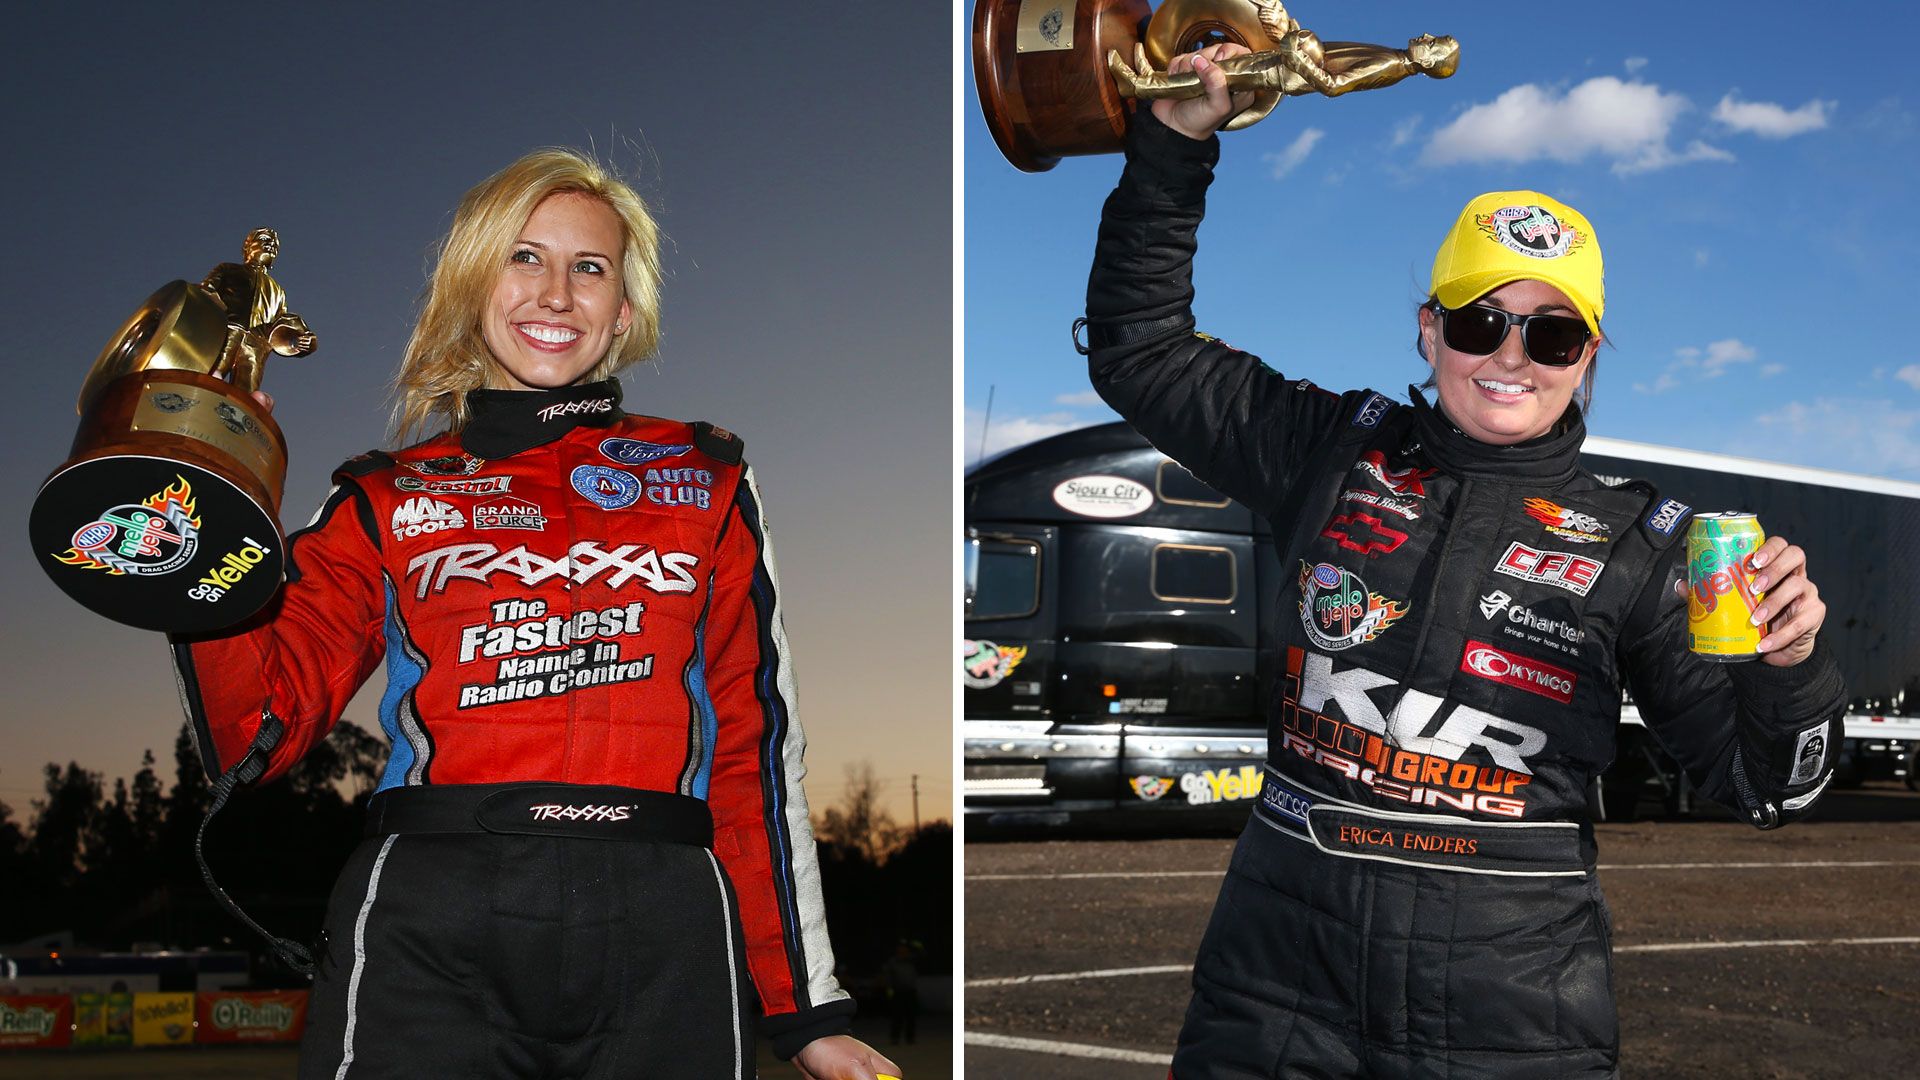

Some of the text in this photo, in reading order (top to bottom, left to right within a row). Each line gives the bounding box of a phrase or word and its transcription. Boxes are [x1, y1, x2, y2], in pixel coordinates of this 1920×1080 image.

[1510, 207, 1554, 234] mello
[1520, 223, 1558, 249] yello
[537, 398, 612, 422] TRAXXAS
[619, 443, 672, 459] Ford
[425, 476, 502, 493] Castrol
[591, 479, 620, 491] AAA
[645, 468, 713, 488] AUTO
[1066, 481, 1142, 499] Sioux City
[476, 505, 538, 515] BRAND
[646, 485, 712, 510] CLUB
[392, 497, 464, 529] MAC
[476, 516, 541, 527] SOURCE
[79, 525, 111, 546] NHRA
[104, 512, 149, 558] mello
[138, 517, 182, 557] yello
[393, 520, 465, 541] TOOLS
[163, 556, 185, 570] RACING
[184, 540, 194, 557] SERIES
[198, 536, 271, 590] Yello!
[1501, 544, 1601, 589] CFE
[406, 541, 699, 599] TRAXXAS
[1497, 567, 1526, 579] RACING
[188, 584, 211, 600] Go
[206, 587, 226, 603] on
[1316, 573, 1362, 611] mello
[493, 599, 546, 622] The
[1321, 604, 1363, 636] yello
[1508, 605, 1585, 643] Charter
[459, 602, 644, 663] Fastest
[1306, 620, 1351, 648] DRAG RACING SERIES
[1504, 626, 1525, 638] Brings
[1527, 634, 1541, 643] your
[1543, 638, 1560, 650] home
[1561, 644, 1568, 652] to
[498, 643, 618, 679] Name In
[459, 656, 653, 707] Radio Control
[1510, 663, 1571, 694] KYMCO
[1300, 651, 1548, 775] KLR
[1181, 773, 1209, 793] Go
[1283, 730, 1527, 818] RACING
[1392, 751, 1532, 794] GROUP
[1188, 790, 1212, 805] on
[529, 804, 630, 821] TRAXXAS
[1340, 825, 1478, 854] ERICA ENDERS
[214, 1000, 293, 1030] O'Reilly
